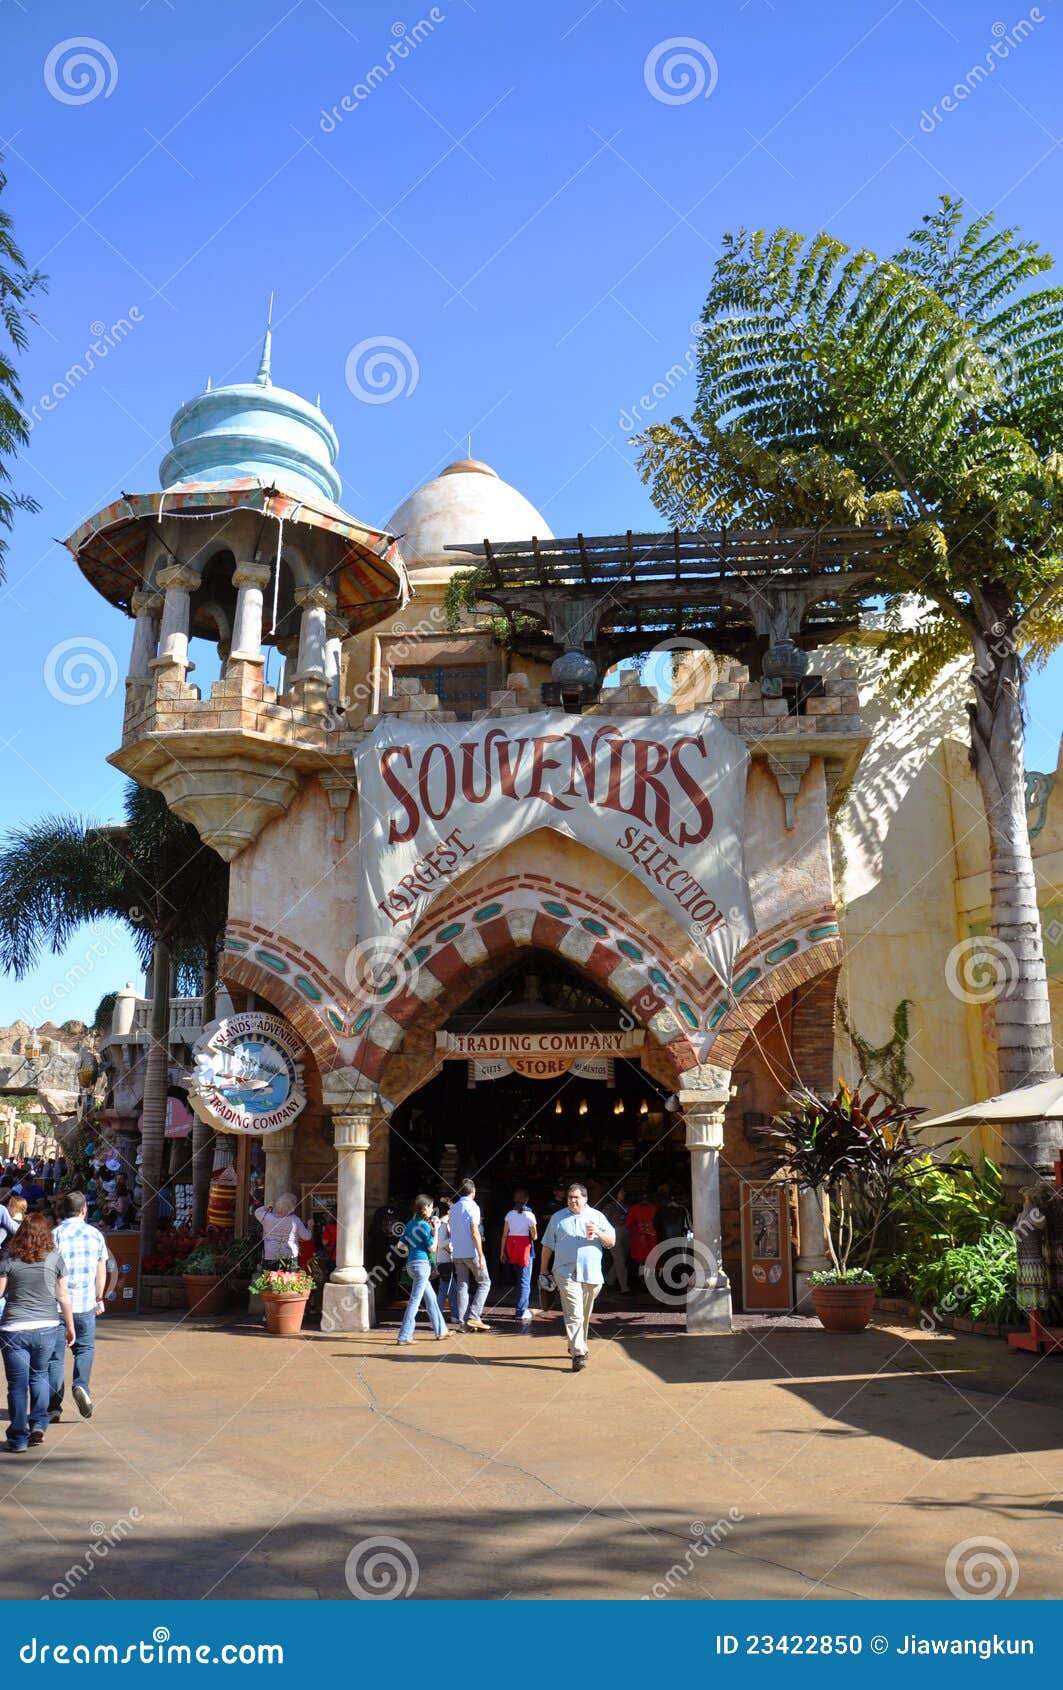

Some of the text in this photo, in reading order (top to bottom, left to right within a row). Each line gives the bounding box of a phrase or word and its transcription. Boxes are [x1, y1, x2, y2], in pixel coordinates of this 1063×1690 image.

[380, 725, 714, 848] SOUVENIRS
[377, 826, 729, 938] LARGEST SELECTION
[213, 1020, 251, 1046] ISLANDS
[257, 1020, 301, 1053] ADVENTURE
[458, 1035, 624, 1051] TRADING COMPANY
[516, 1060, 566, 1073] STORE
[209, 1095, 250, 1129] TRADING
[252, 1098, 301, 1130] COMPANY
